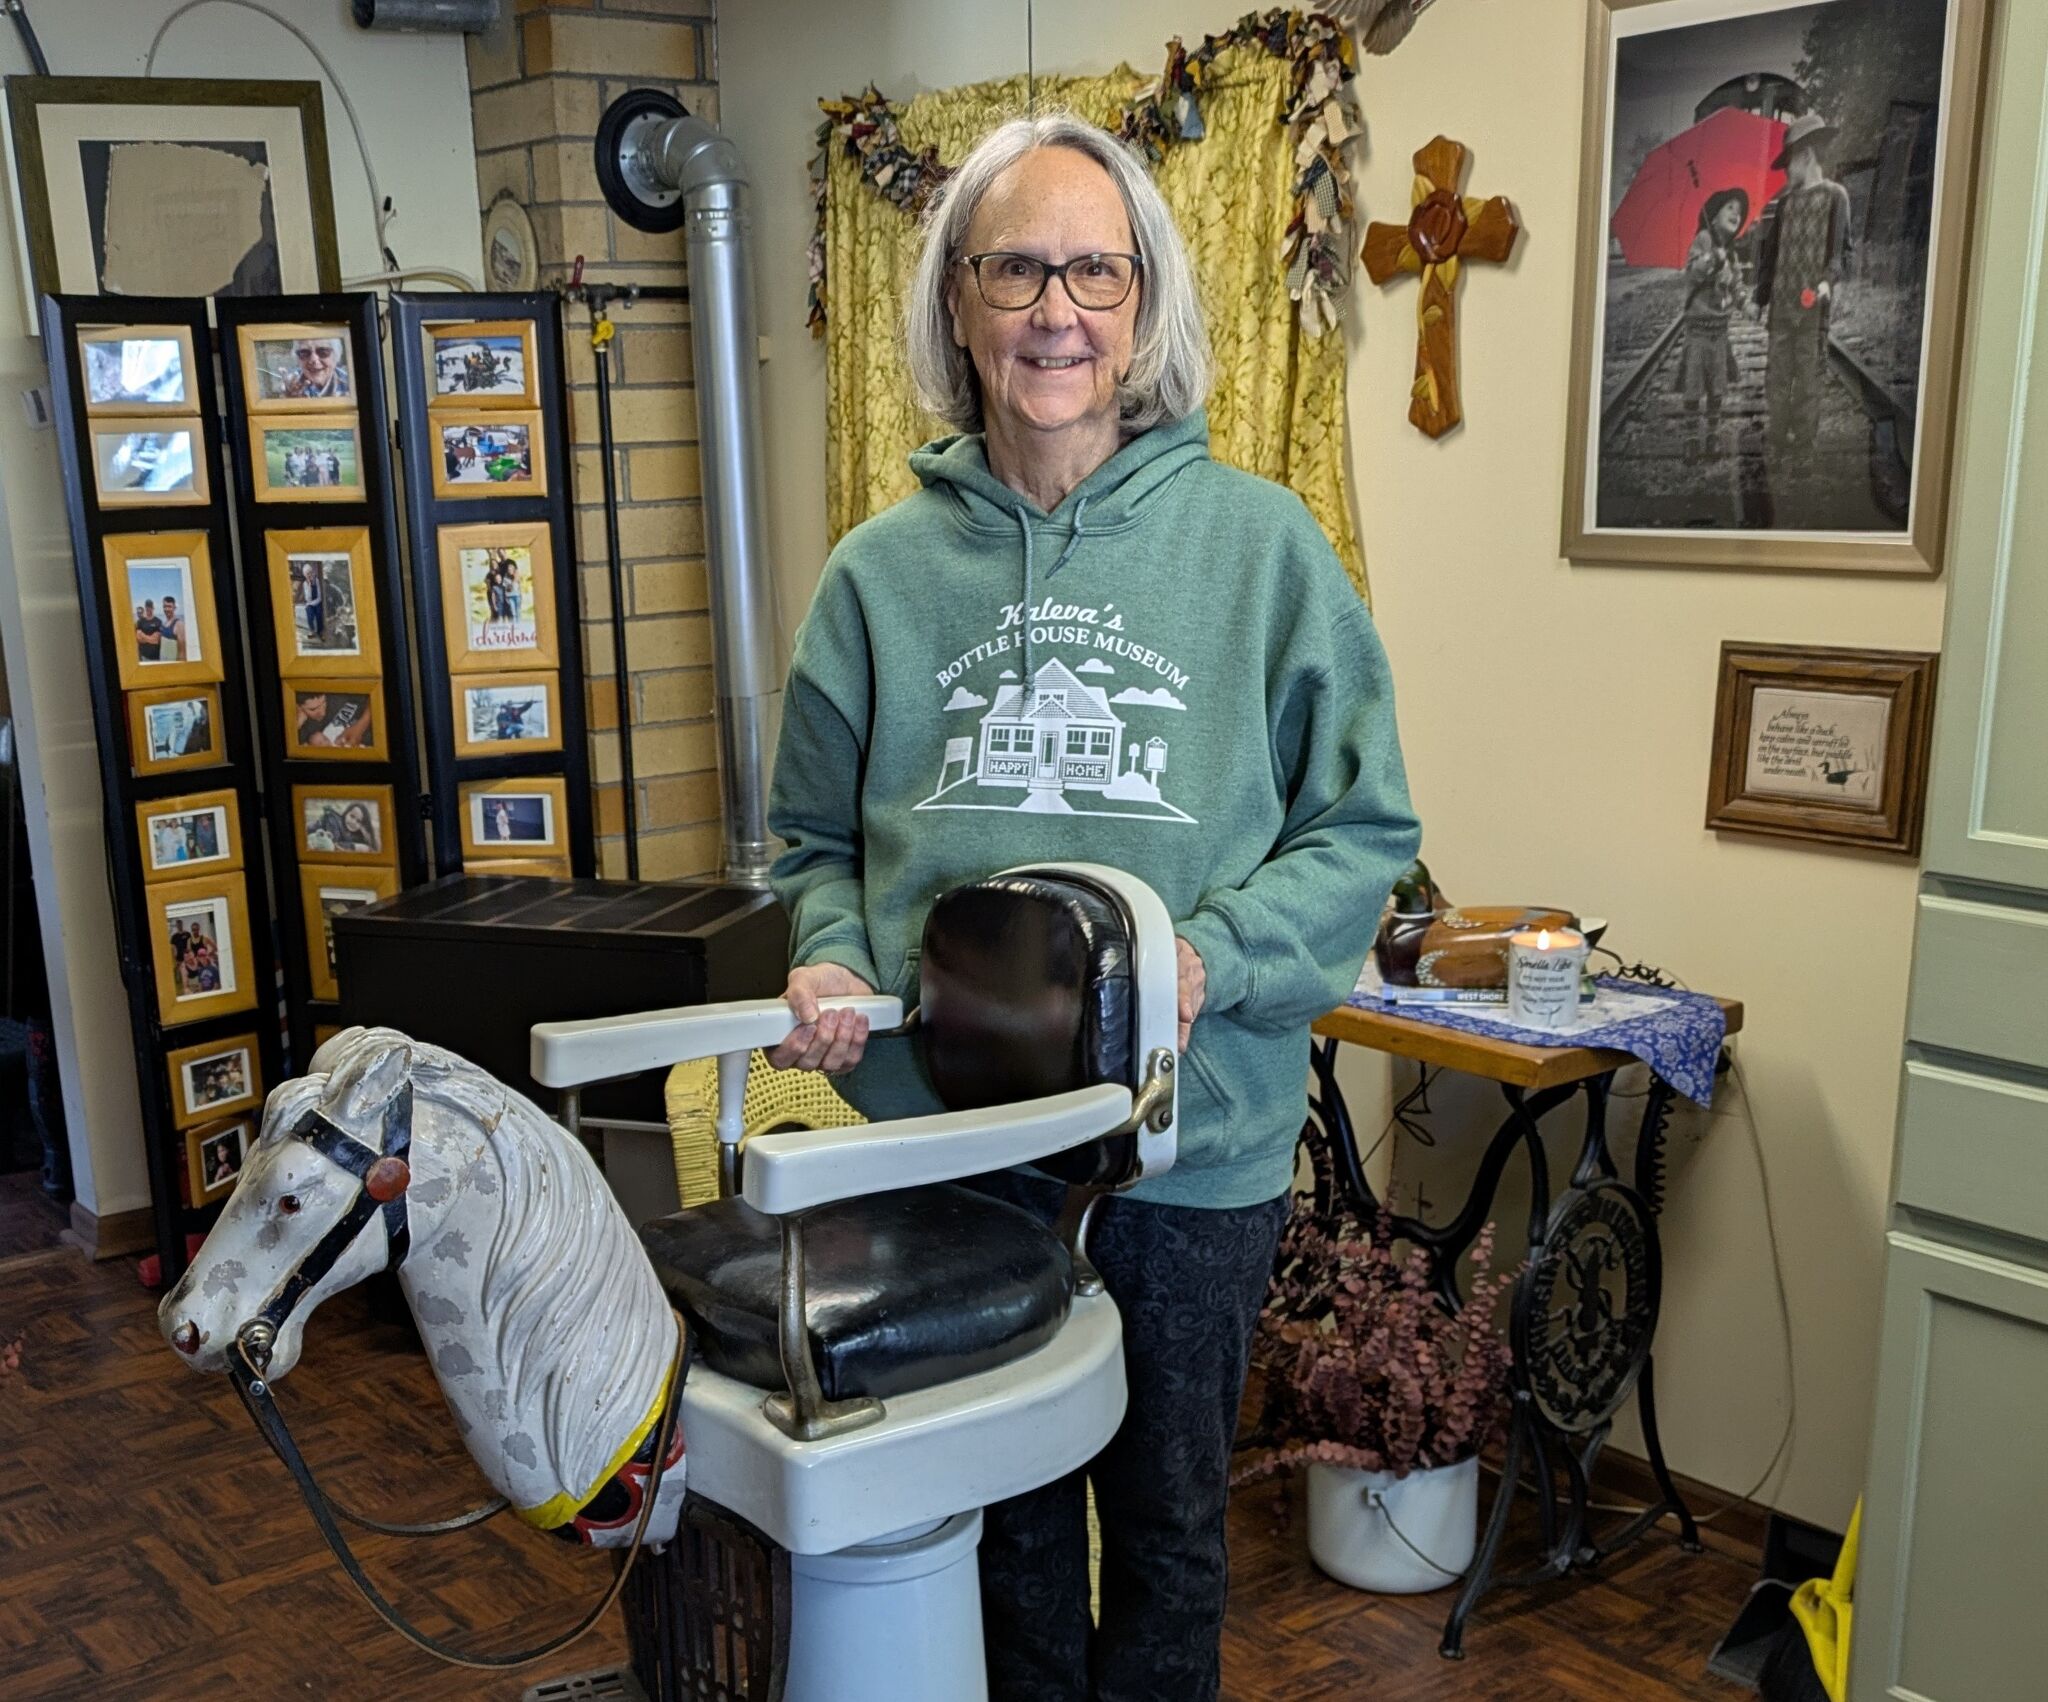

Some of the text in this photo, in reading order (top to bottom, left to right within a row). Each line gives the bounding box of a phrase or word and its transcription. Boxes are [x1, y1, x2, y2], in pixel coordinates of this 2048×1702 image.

[935, 634, 1011, 689] BOTTLE
[1093, 631, 1190, 691] MUSEUM
[989, 760, 1105, 778] HAPPY HOME
[1517, 956, 1549, 970] Smells
[1456, 992, 1478, 1001] WEST
